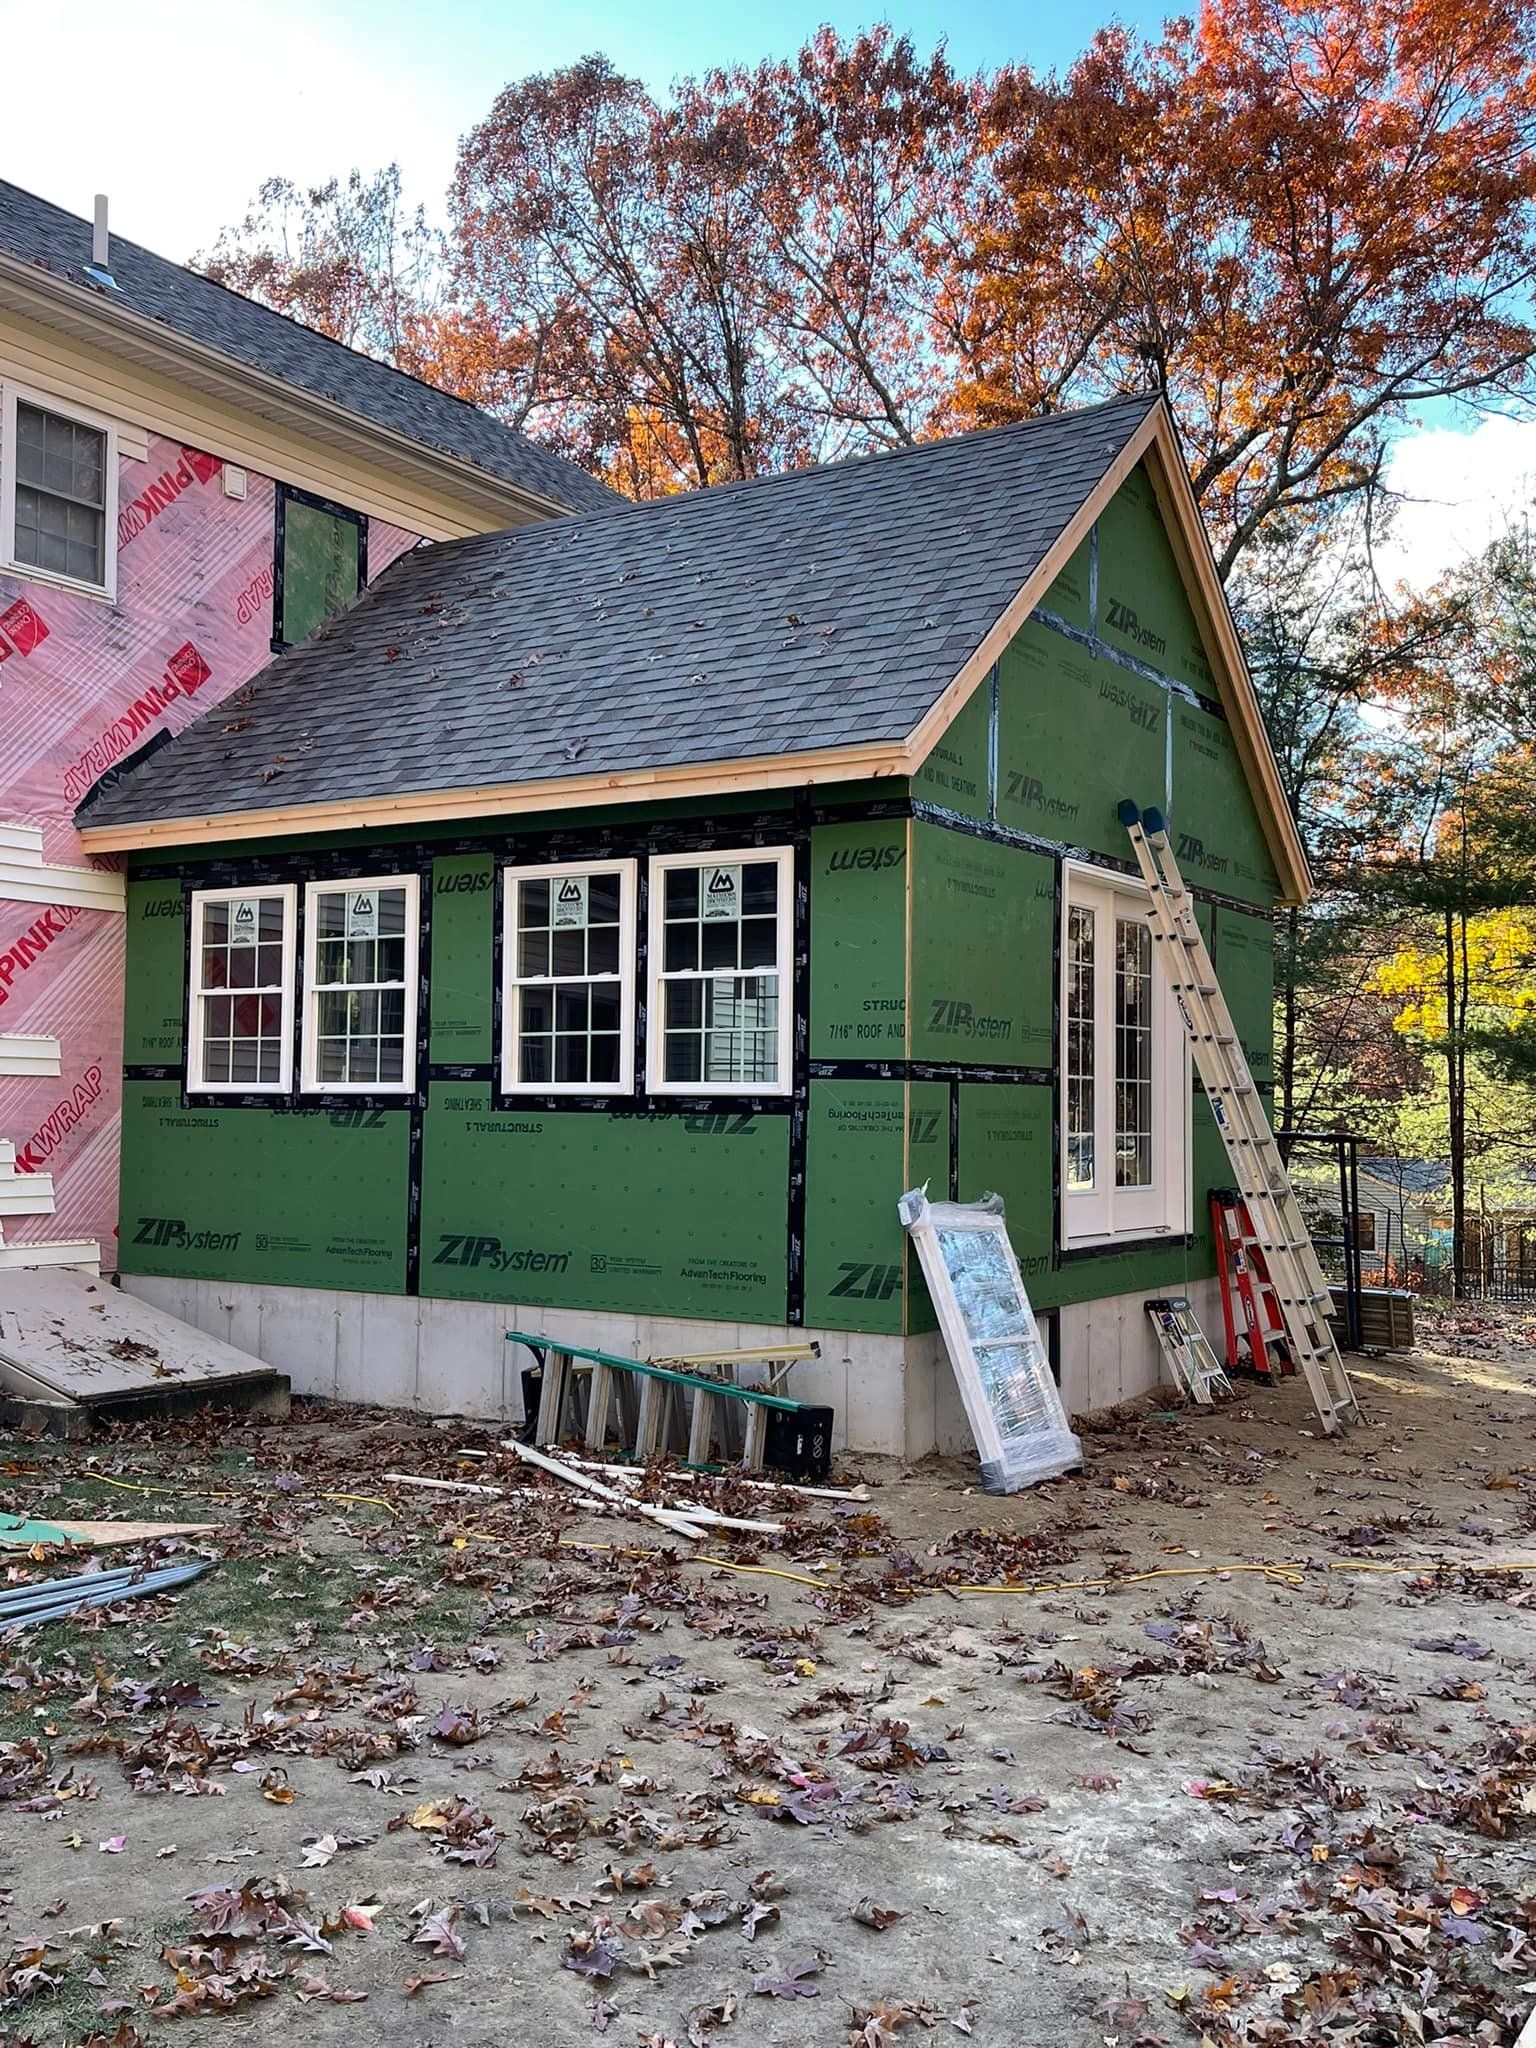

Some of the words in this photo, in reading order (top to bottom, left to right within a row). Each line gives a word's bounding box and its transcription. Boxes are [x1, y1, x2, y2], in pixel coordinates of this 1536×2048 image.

[64, 673, 180, 803] PINKWRAP
[857, 1024, 882, 1039] ROOF
[887, 1024, 905, 1039] AND
[476, 1122, 543, 1133] STRUCTURAL
[131, 1217, 242, 1251] ZIPsystem
[432, 1234, 572, 1273] ZIPsystem
